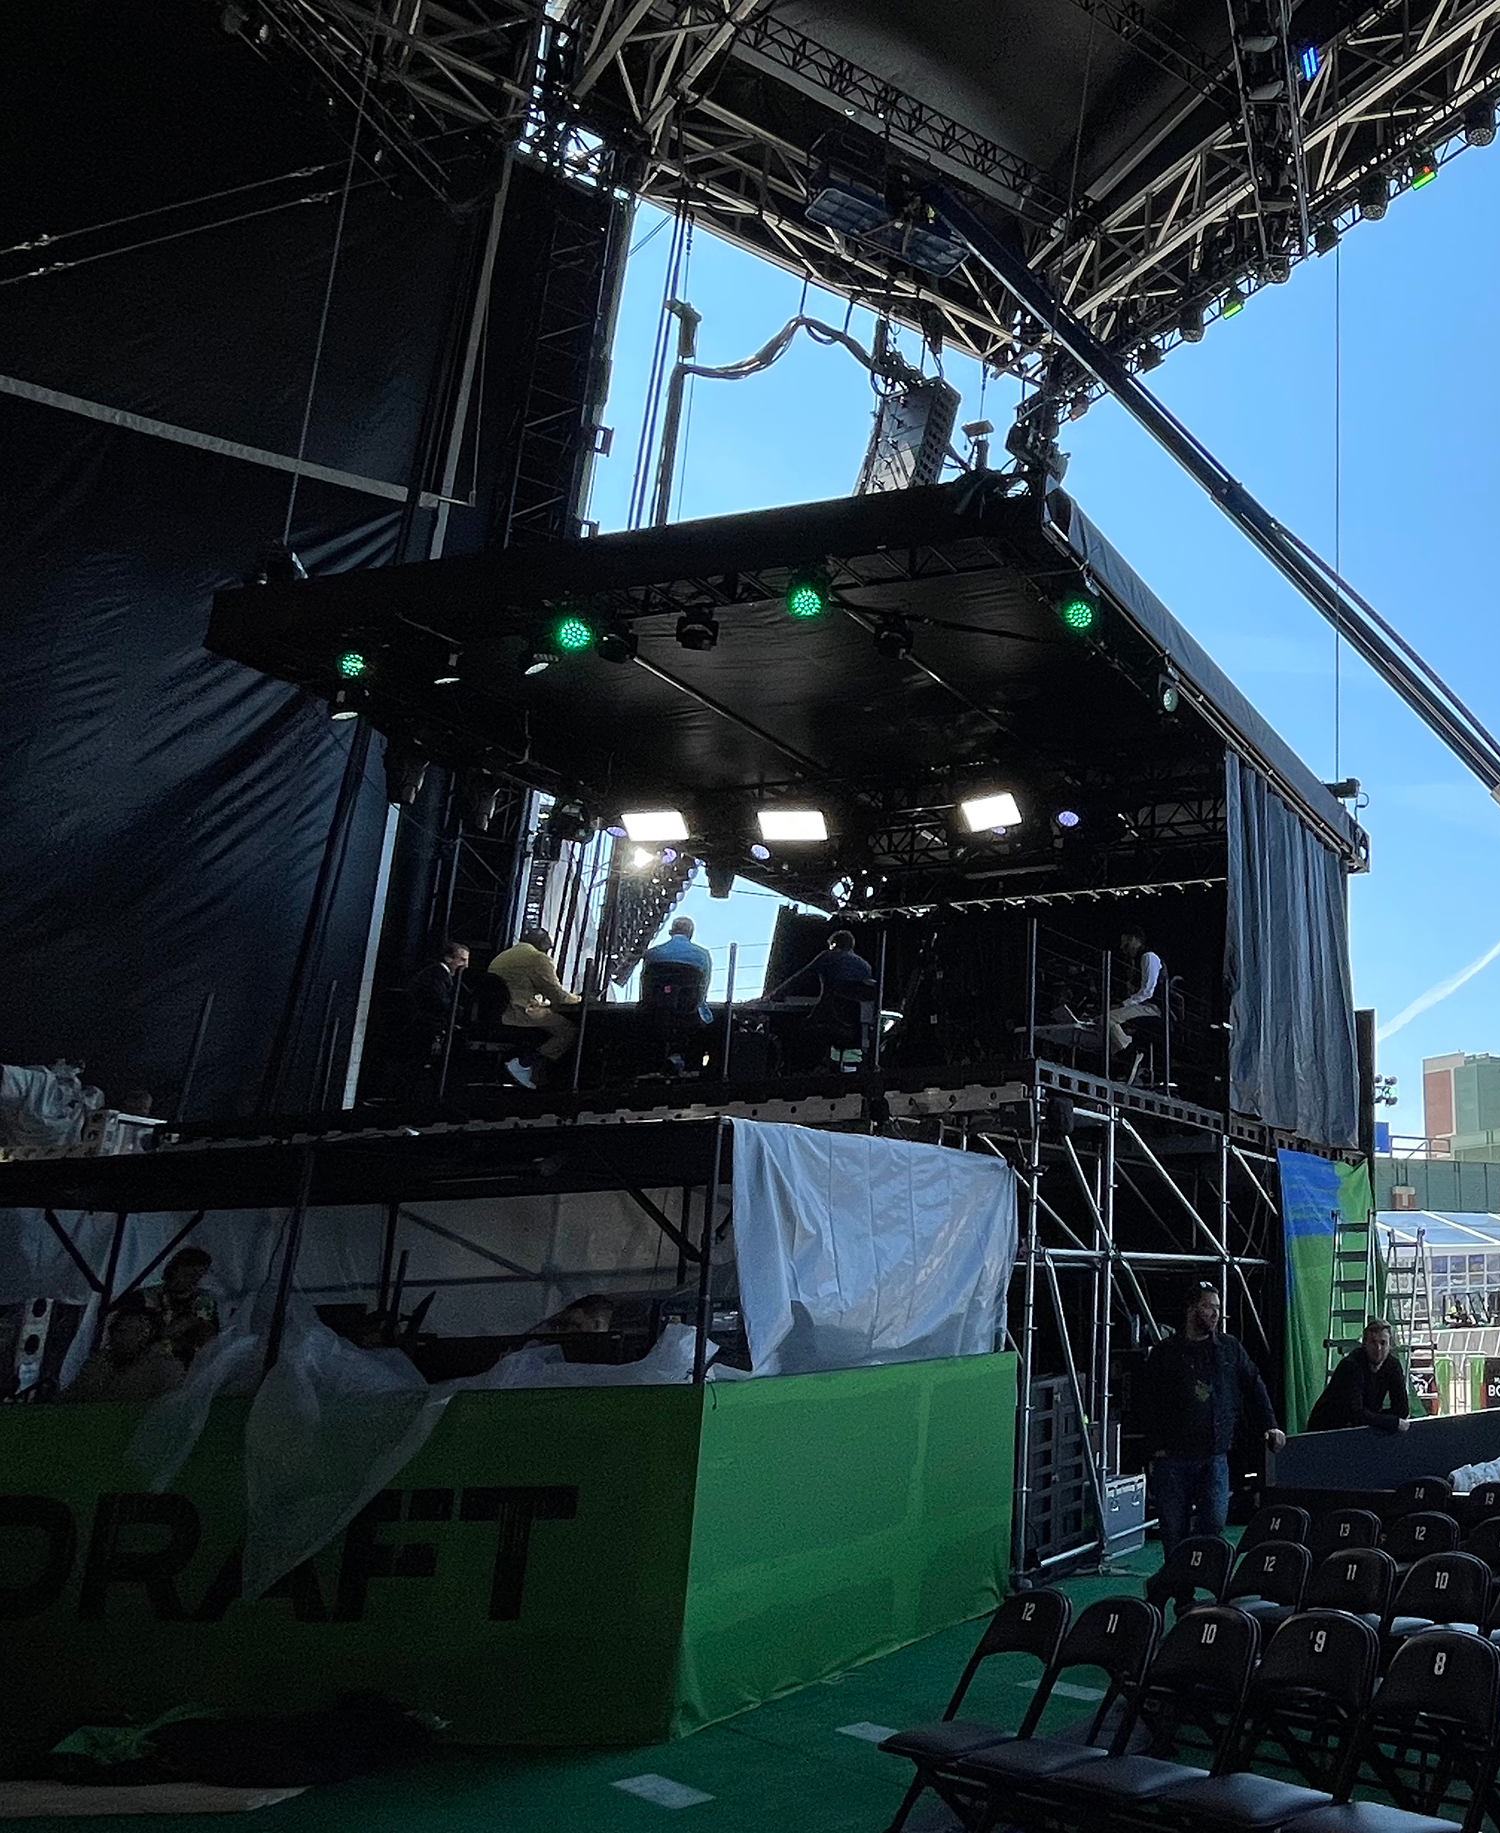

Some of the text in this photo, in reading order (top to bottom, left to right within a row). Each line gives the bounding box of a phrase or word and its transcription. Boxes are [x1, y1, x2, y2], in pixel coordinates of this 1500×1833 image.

[1414, 1487, 1425, 1499] 14
[1485, 1492, 1495, 1505] 13
[1269, 1517, 1281, 1531] 14
[1339, 1523, 1351, 1537] 13
[1414, 1526, 1427, 1541] 12
[1190, 1550, 1203, 1567] 13
[1263, 1555, 1276, 1572] 12
[1346, 1564, 1358, 1580] 11
[1434, 1571, 1449, 1589] 10
[1021, 1602, 1036, 1622] 12
[1106, 1613, 1119, 1634] 11
[1200, 1623, 1218, 1644] 10
[1314, 1630, 1327, 1653] 9
[1433, 1652, 1447, 1675] 8
